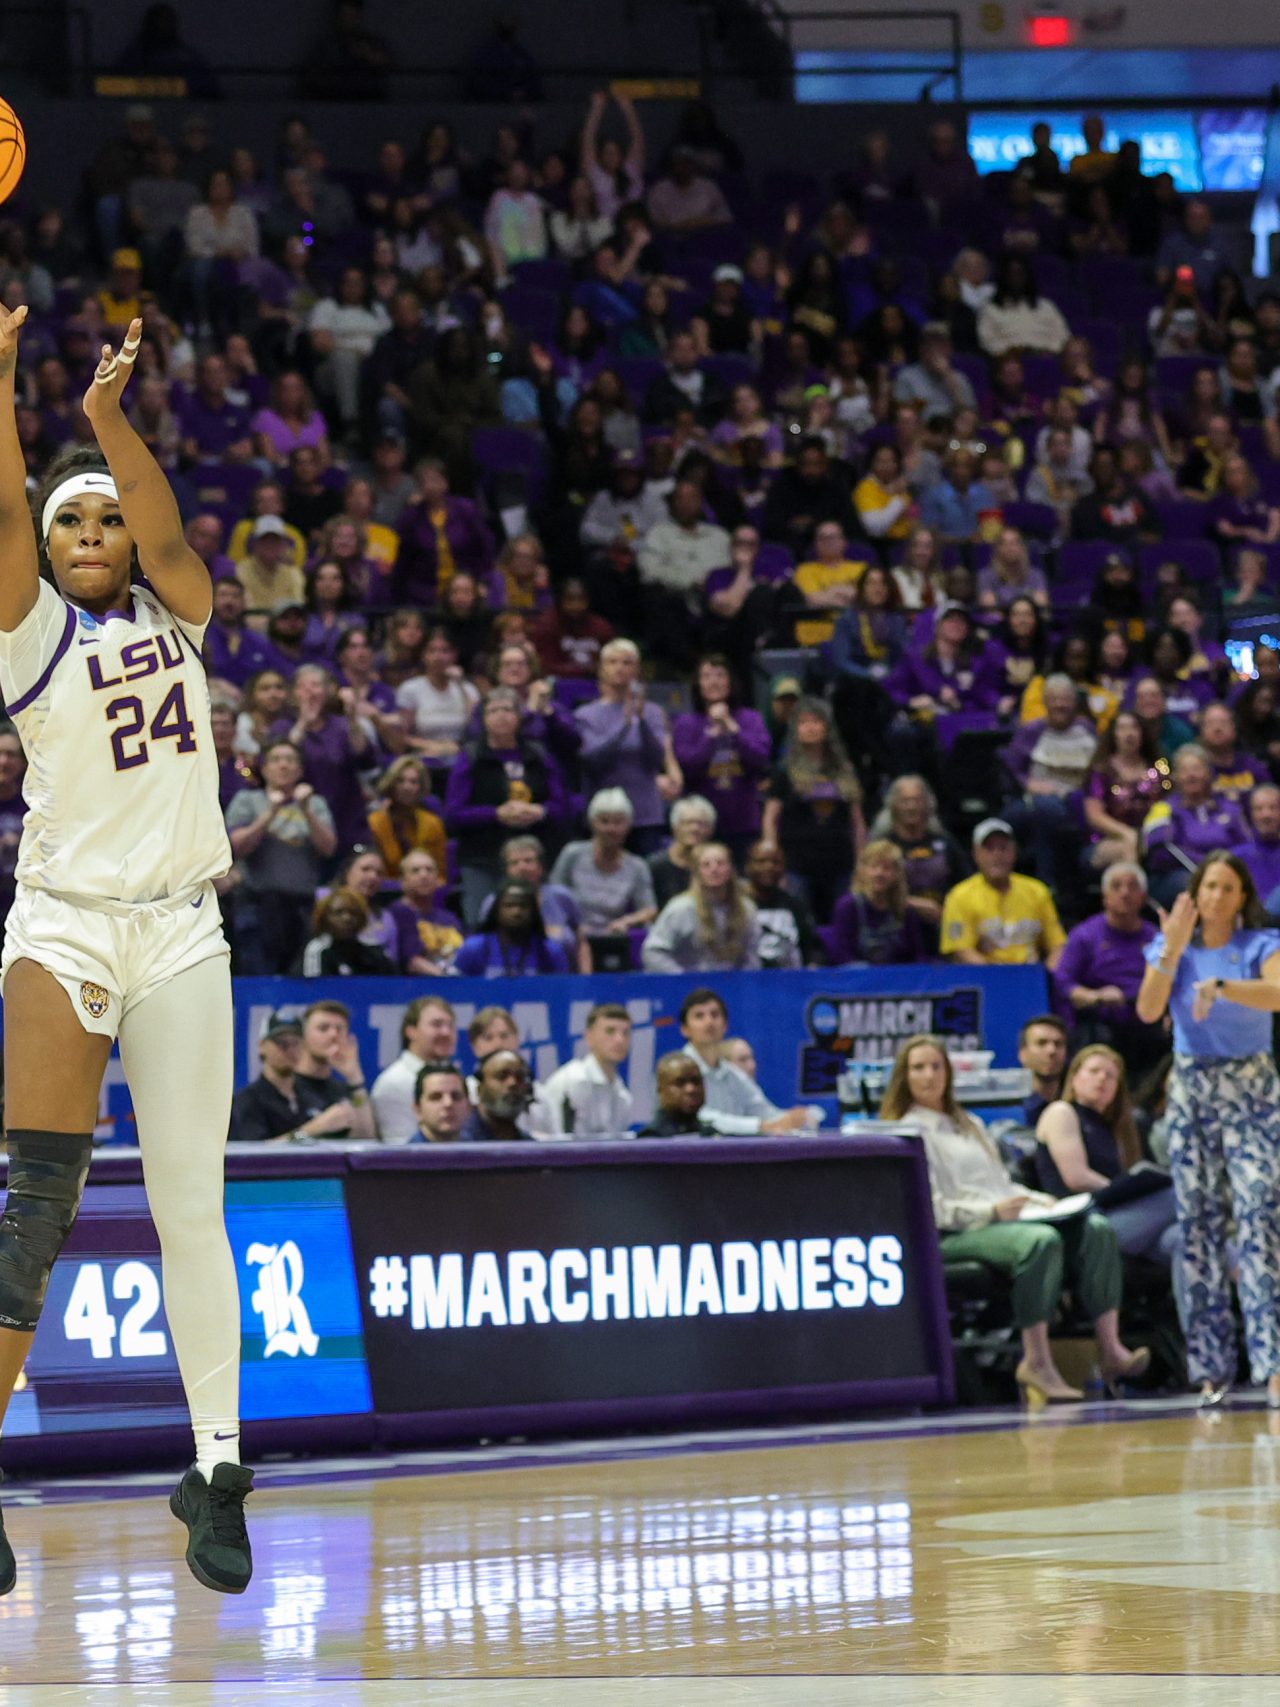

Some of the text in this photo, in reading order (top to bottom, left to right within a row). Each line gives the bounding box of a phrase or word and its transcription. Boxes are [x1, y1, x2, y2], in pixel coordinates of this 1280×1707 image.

[86, 628, 185, 691] LSU
[105, 681, 198, 772] 24
[838, 1001, 933, 1036] MARCH
[63, 1261, 168, 1358] 42
[369, 1235, 905, 1330] #MARCHMADNESS
